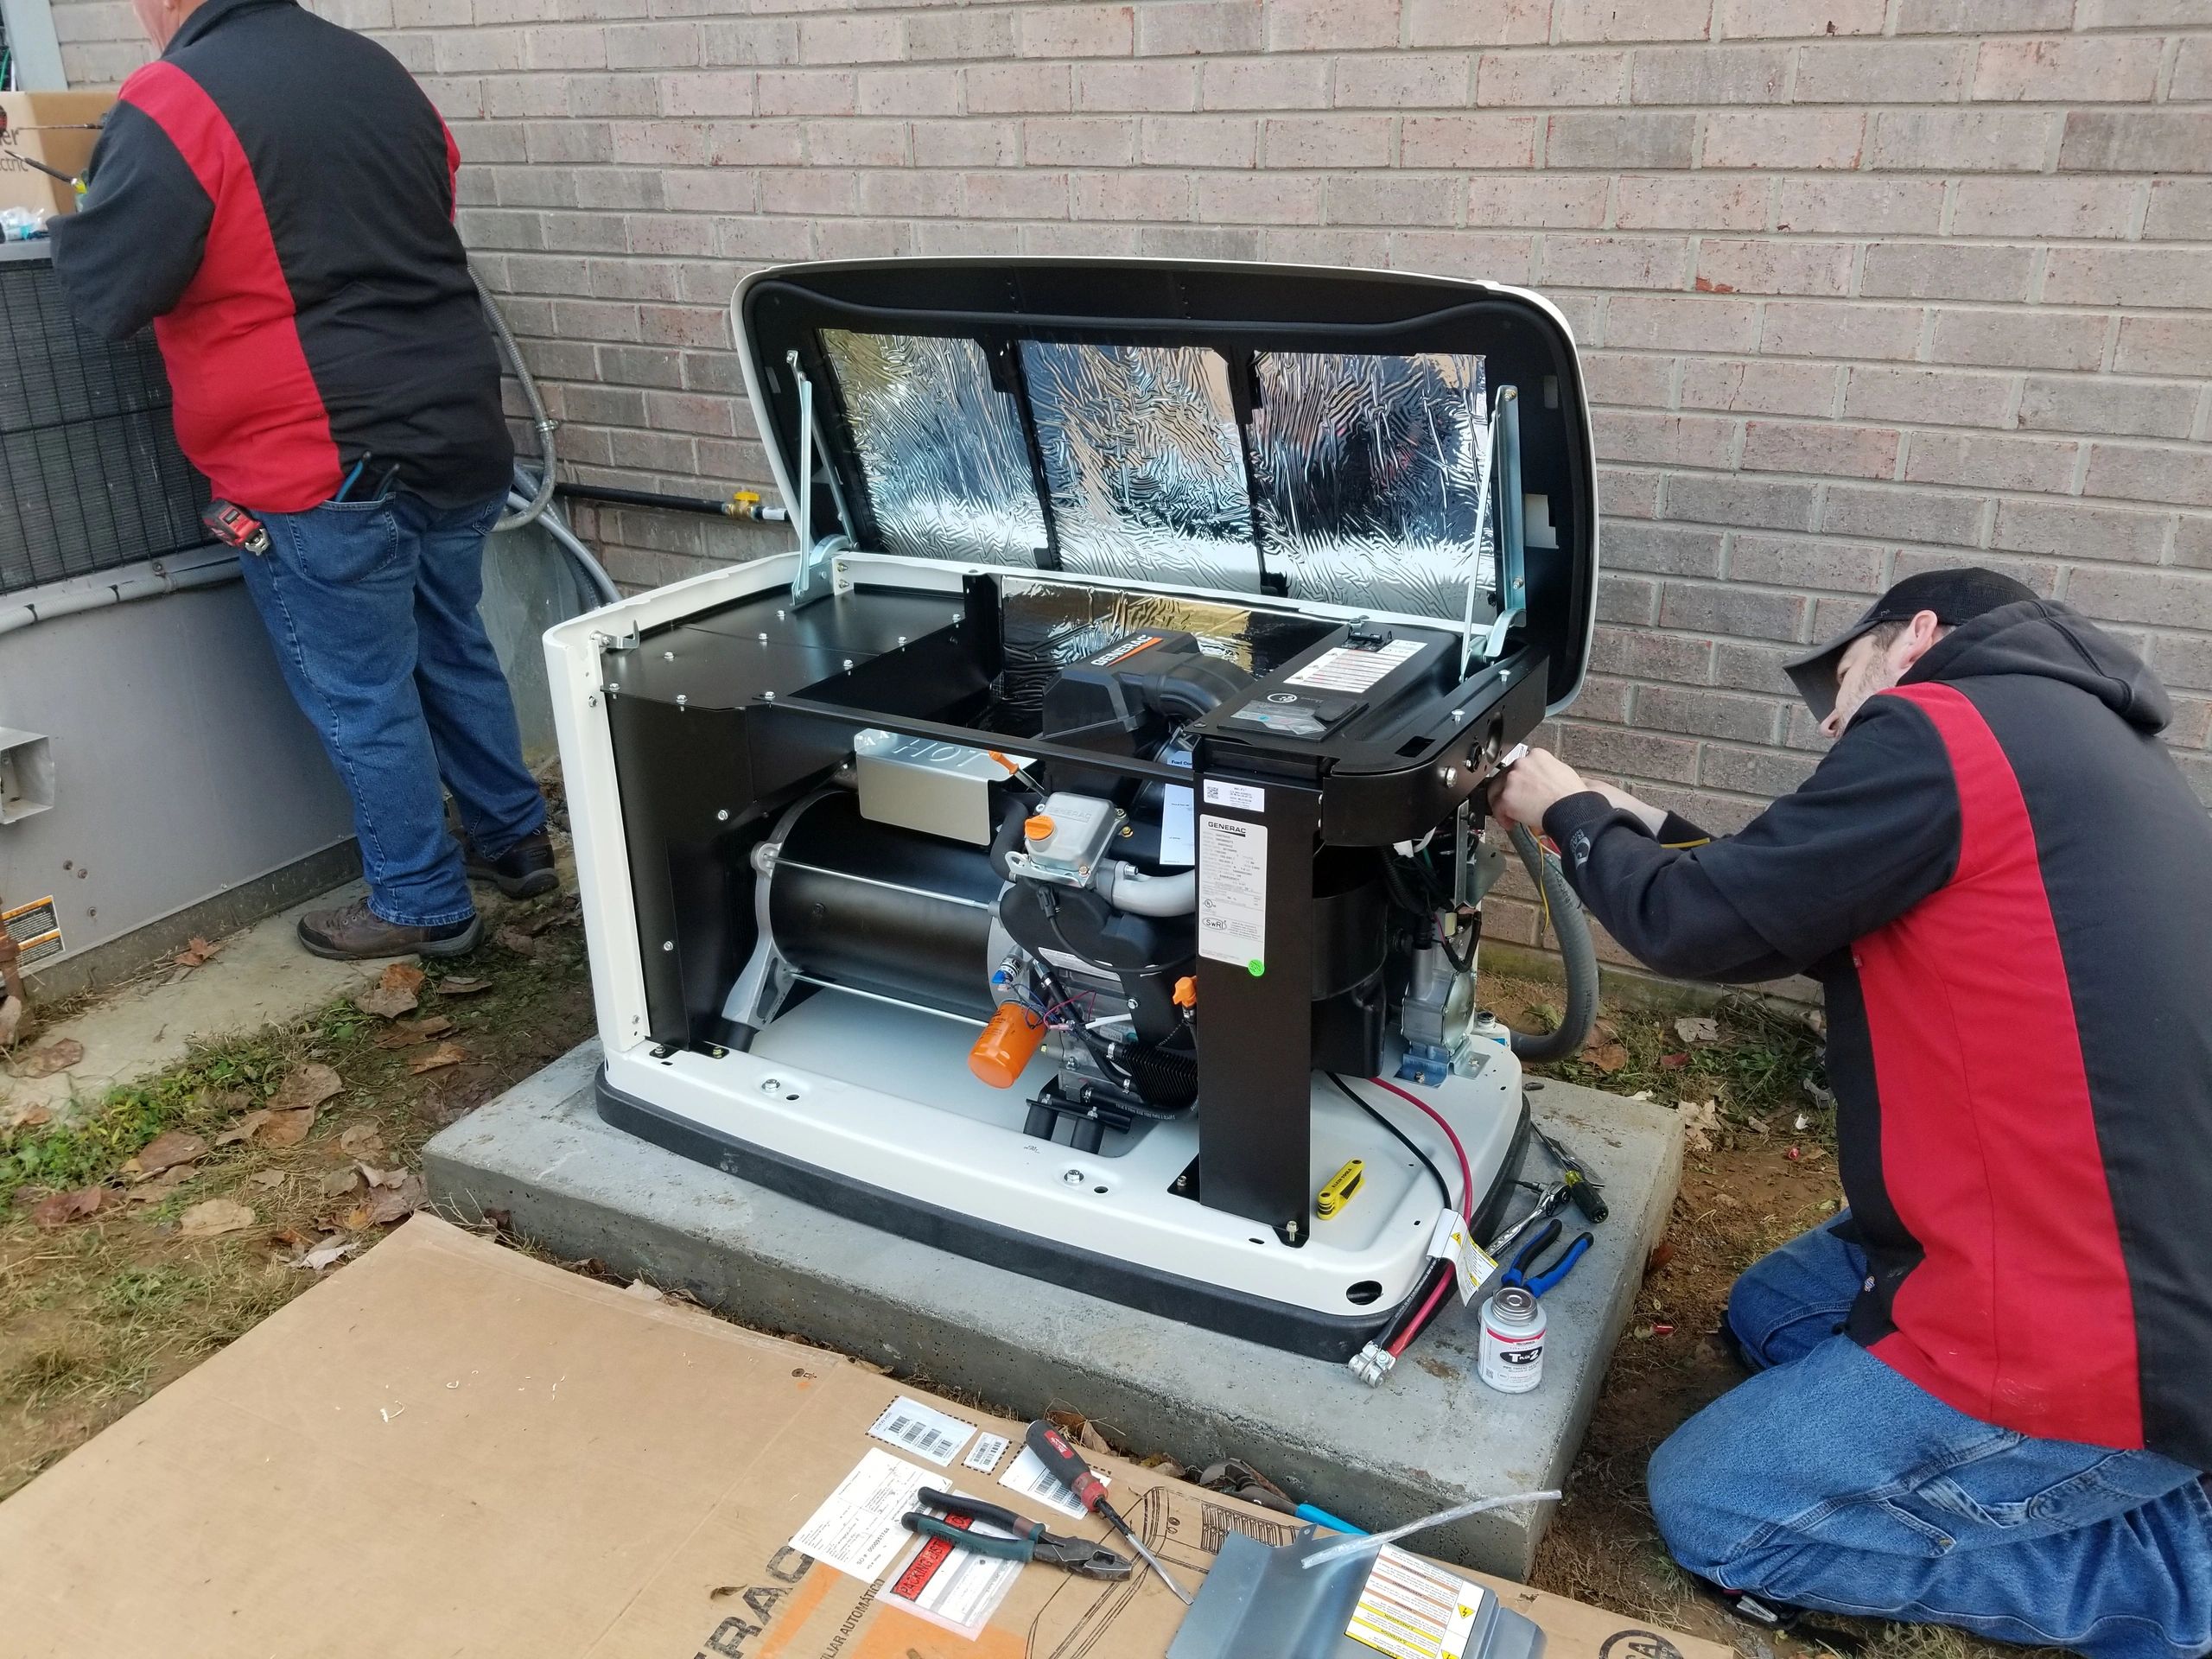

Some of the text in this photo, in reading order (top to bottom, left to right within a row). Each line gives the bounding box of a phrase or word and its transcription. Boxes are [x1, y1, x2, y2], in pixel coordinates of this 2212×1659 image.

[0, 157, 29, 172] ctric
[1090, 634, 1153, 667] GENERAC
[893, 739, 990, 767] HOT
[1207, 821, 1247, 834] GENERAC
[899, 1539, 944, 1596] PACKING LIST
[692, 1545, 815, 1659] RAC
[819, 1578, 886, 1659] ILIAR AUTOMÁTICO
